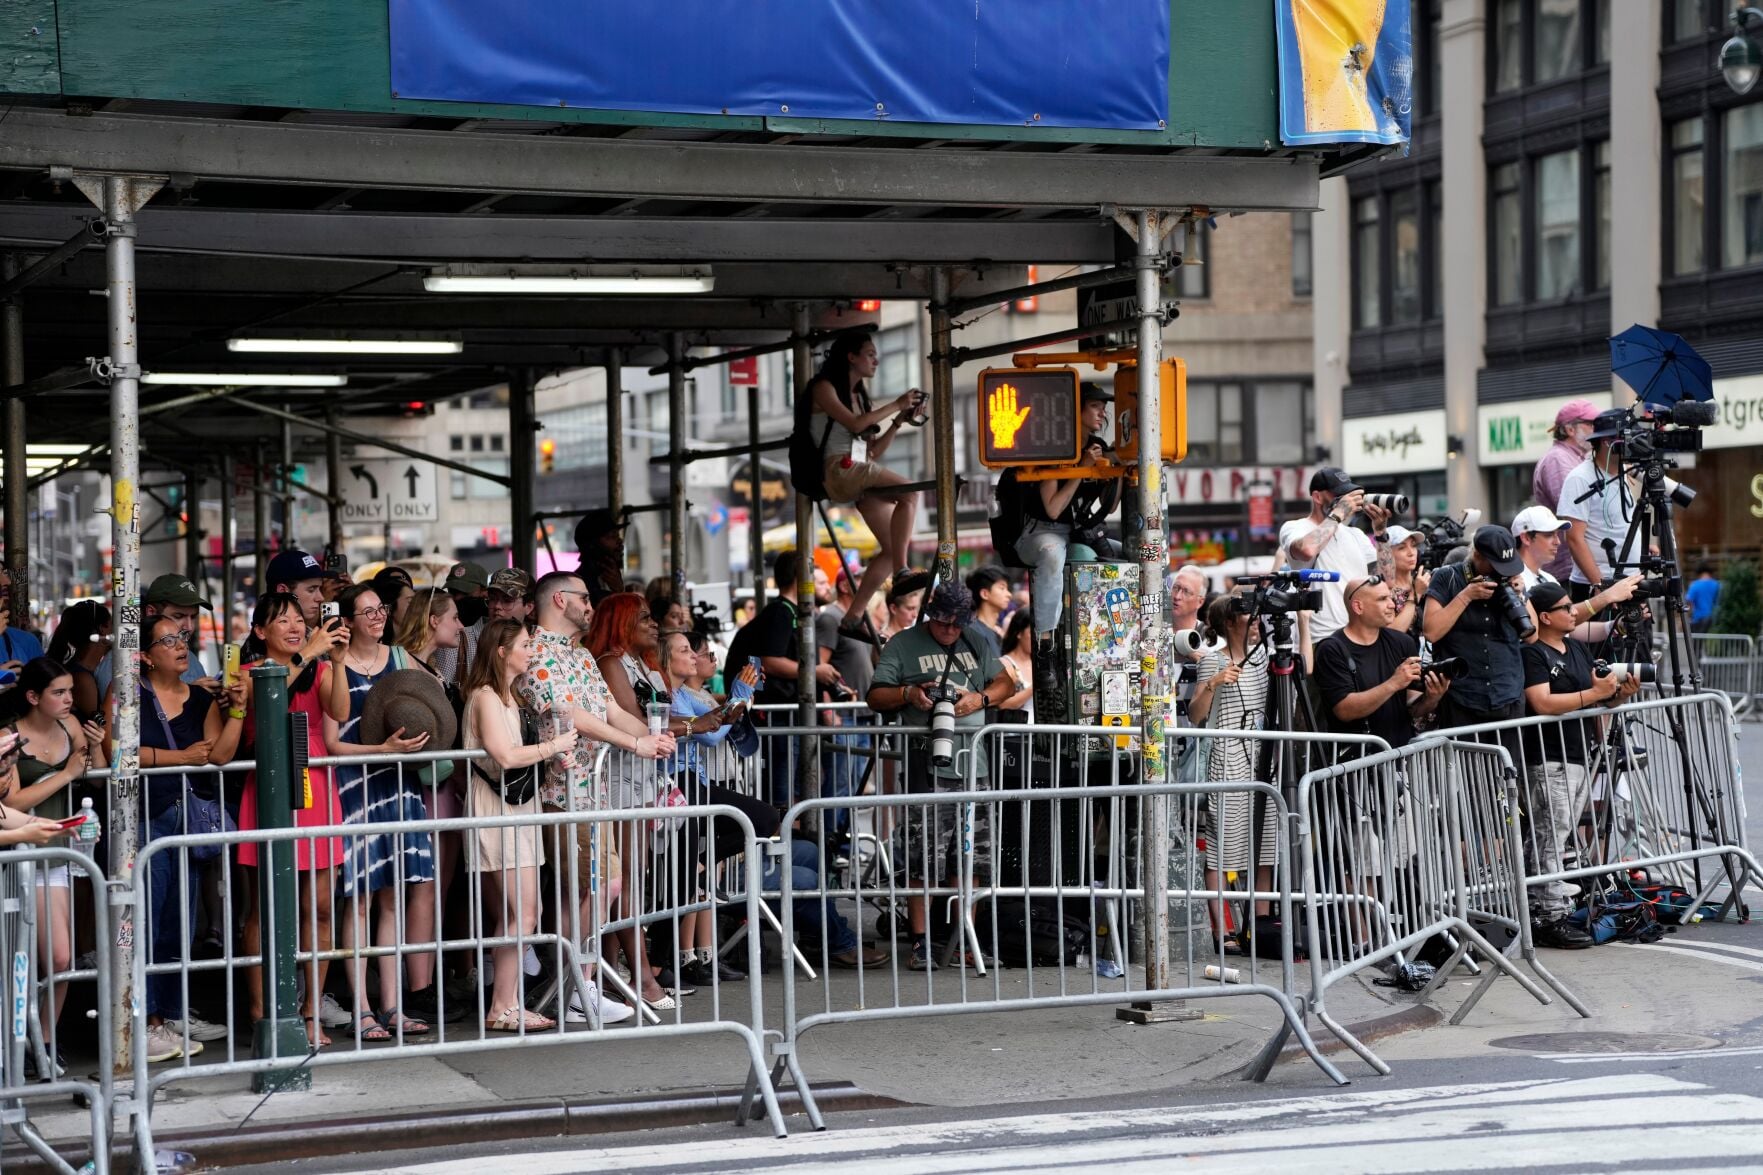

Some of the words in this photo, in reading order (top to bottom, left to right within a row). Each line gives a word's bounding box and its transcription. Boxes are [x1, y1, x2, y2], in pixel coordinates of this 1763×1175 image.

[1088, 303, 1106, 325] ONE
[1489, 416, 1523, 453] NAYA
[345, 503, 382, 517] ONLY
[394, 503, 431, 516] ONLY
[1502, 547, 1514, 559] NY
[15, 954, 26, 1037] NYPD
